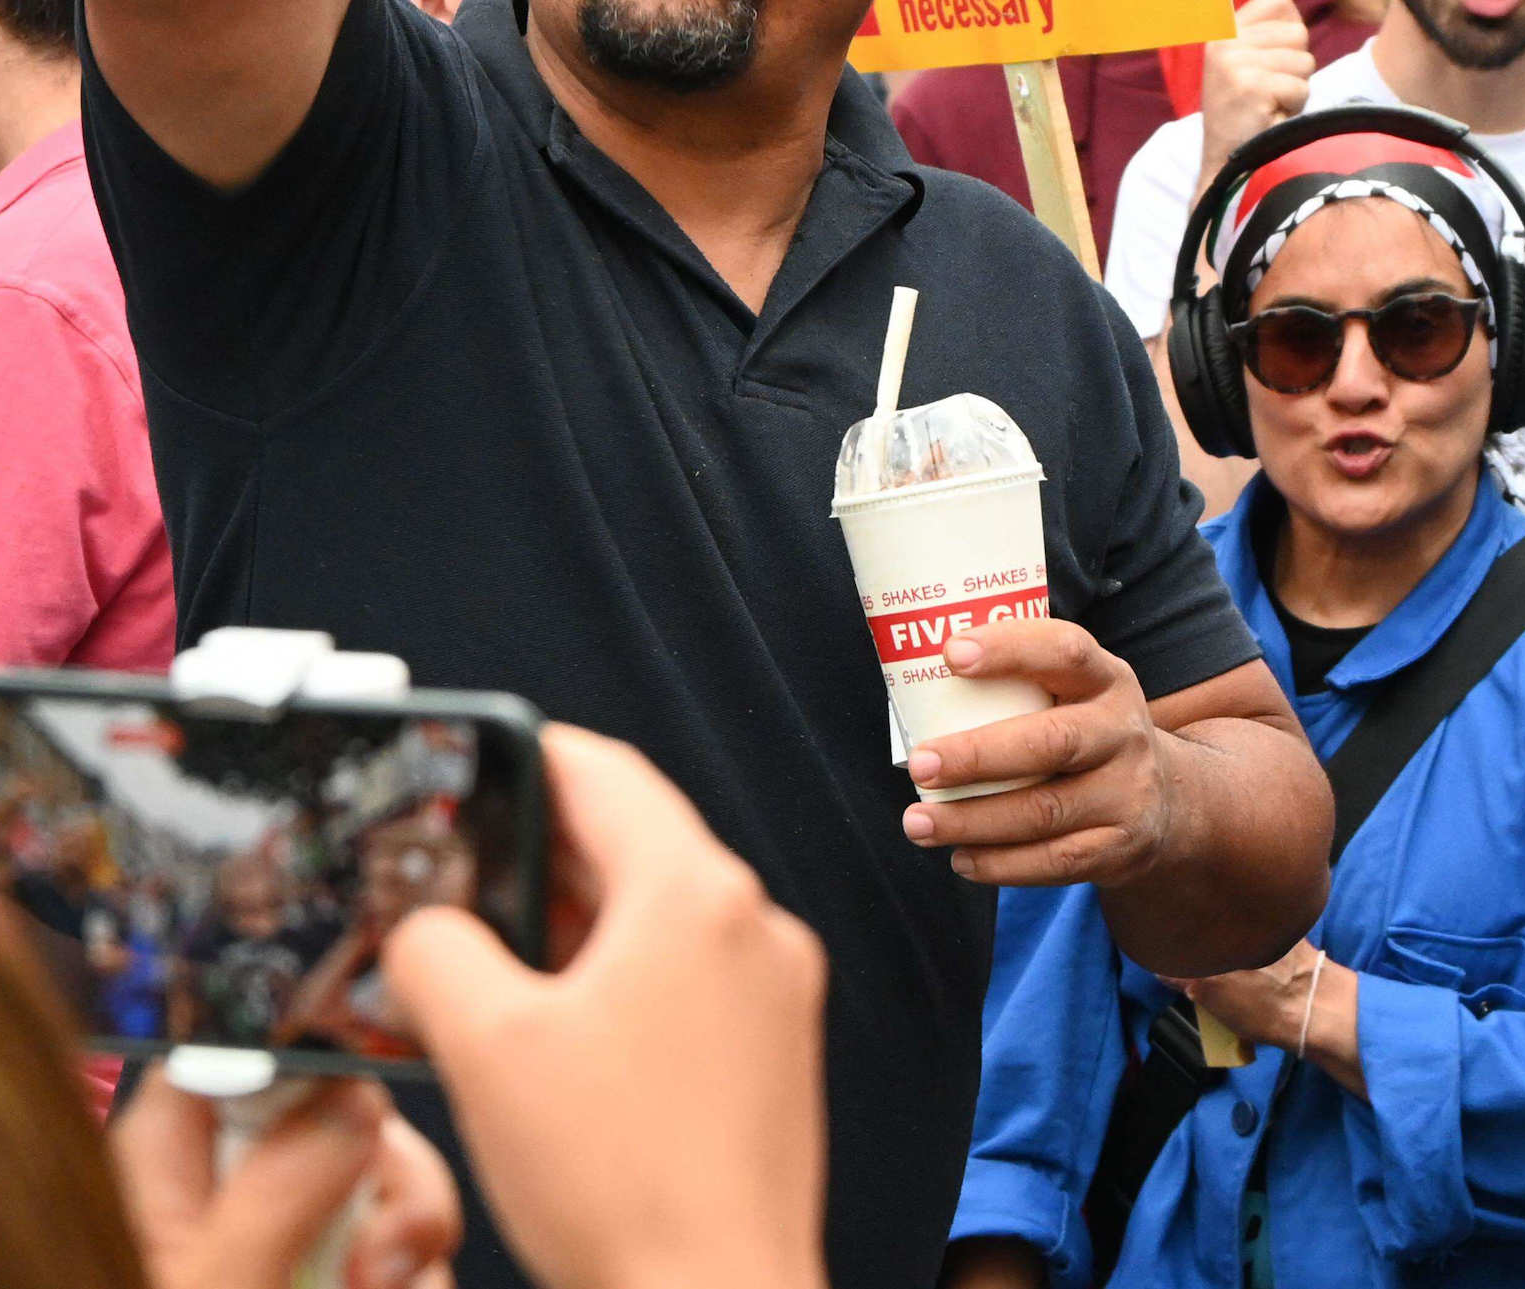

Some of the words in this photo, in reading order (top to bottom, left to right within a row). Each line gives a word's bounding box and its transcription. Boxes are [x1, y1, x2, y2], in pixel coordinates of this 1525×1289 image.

[882, 583, 947, 607] SHAKES
[963, 567, 1028, 593] SHAKES
[890, 611, 973, 651] FIVE
[988, 596, 1050, 623] GUY
[903, 664, 954, 685] SHAKE
